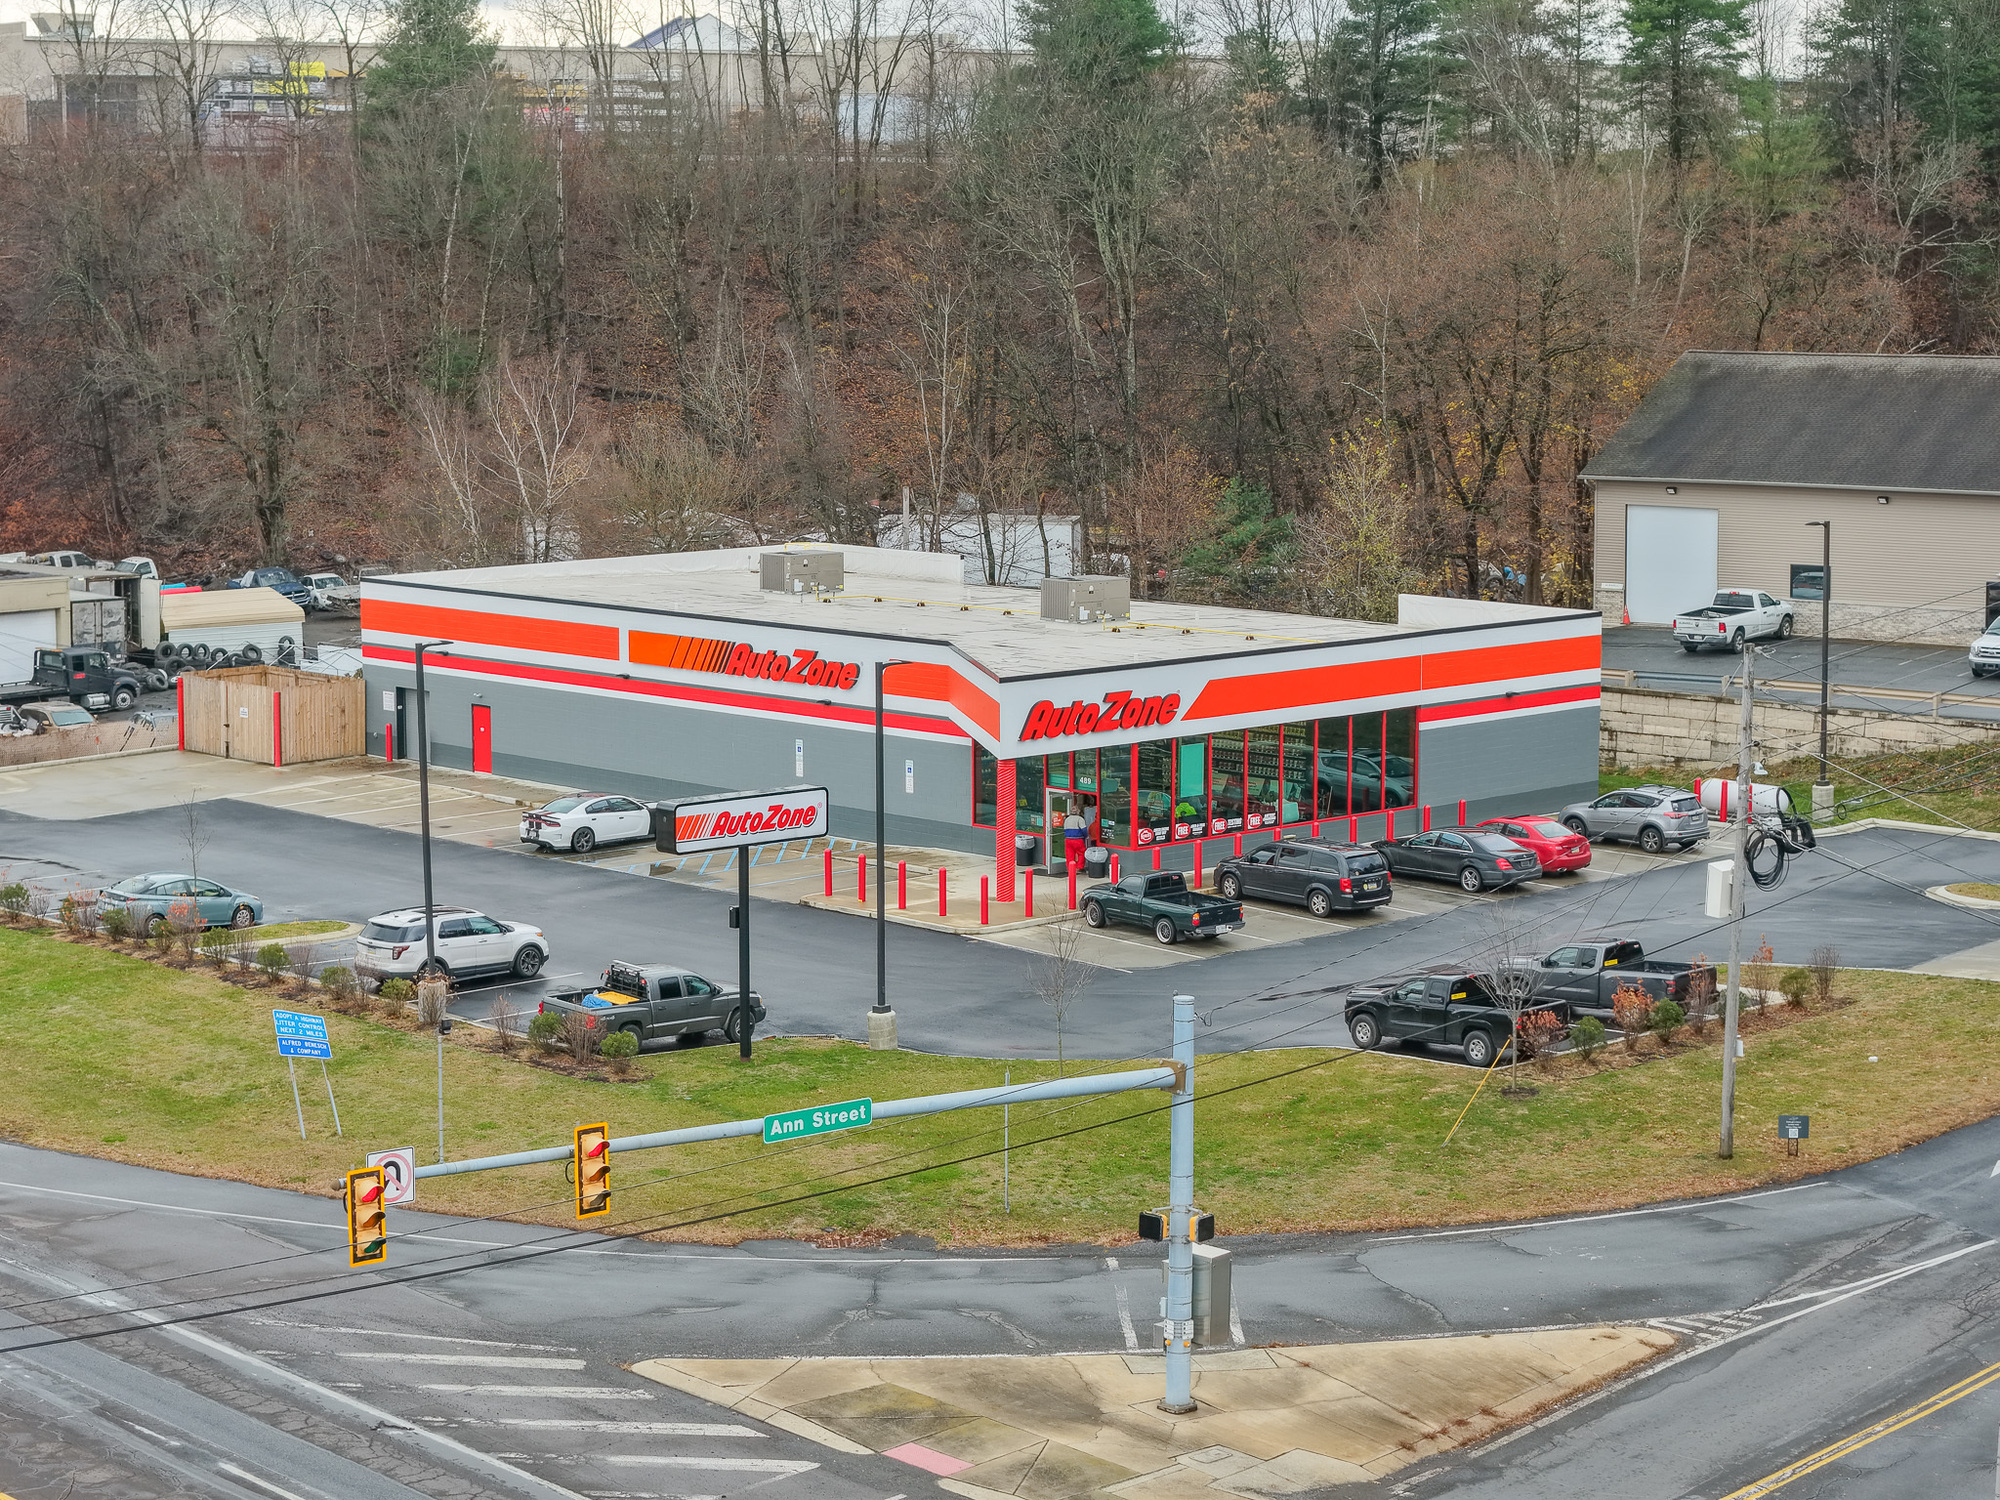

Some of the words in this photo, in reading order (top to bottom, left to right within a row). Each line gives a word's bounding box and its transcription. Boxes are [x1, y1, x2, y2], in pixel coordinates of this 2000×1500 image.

[725, 643, 860, 690] AutoZone
[1018, 690, 1181, 741] AutoZone
[1080, 776, 1092, 784] 489
[709, 804, 818, 838] AutoZone
[1215, 821, 1225, 830] FREE
[1250, 816, 1261, 826] FREE
[1178, 826, 1188, 835] FREE
[298, 1022, 324, 1031] CONTROL
[770, 1119, 804, 1136] Ann
[812, 1105, 866, 1128] Street
